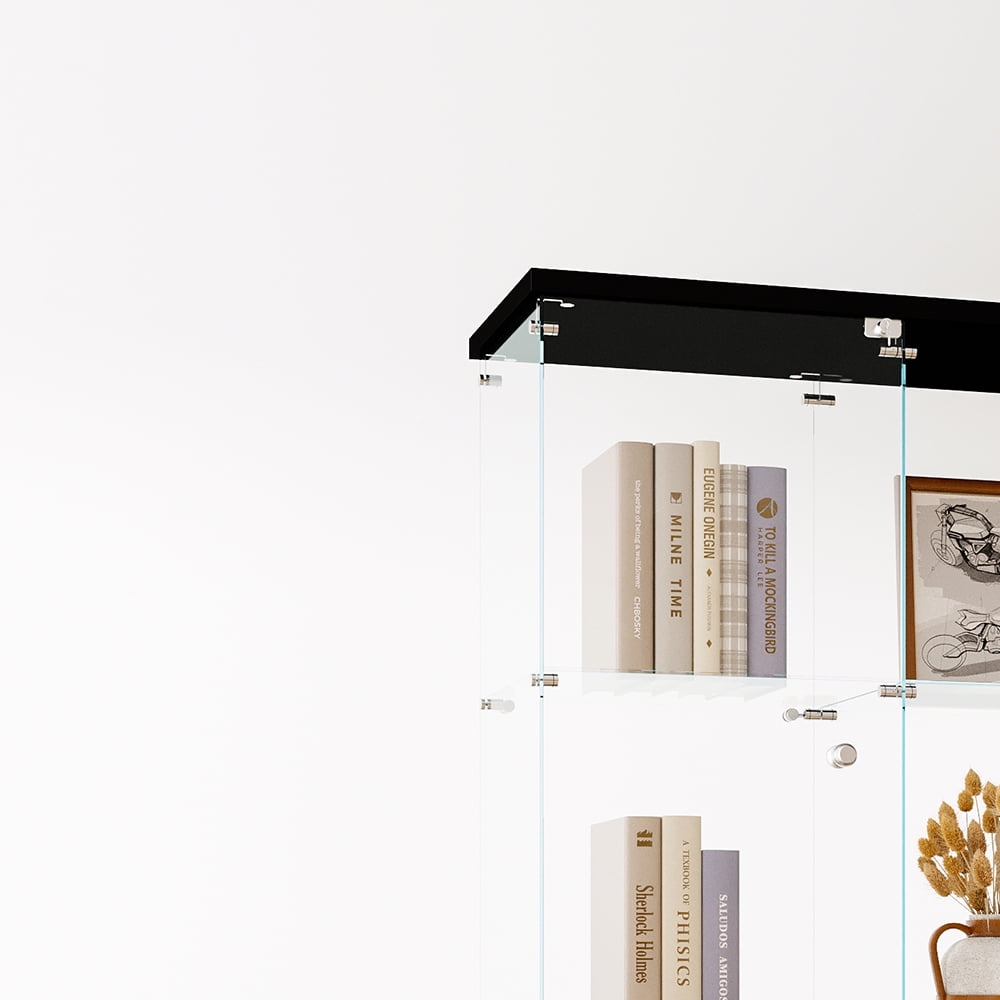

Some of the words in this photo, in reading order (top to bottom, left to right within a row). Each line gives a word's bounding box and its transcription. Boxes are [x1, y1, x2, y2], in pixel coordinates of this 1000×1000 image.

[634, 480, 642, 492] the
[703, 468, 715, 512] EUGENE
[634, 515, 642, 524] of
[703, 517, 715, 559] ONEGIN
[765, 527, 776, 541] TO
[670, 515, 682, 565] MILNE
[765, 543, 776, 564] KILL
[634, 551, 642, 588] wallflower
[765, 567, 776, 575] A
[633, 597, 641, 639] CHBOSKY
[670, 580, 682, 618] TIME
[765, 578, 776, 654] MOCKINGBIRD
[682, 850, 690, 889] TEXBOOK
[635, 885, 654, 935] Sherlock
[682, 894, 690, 905] OF
[719, 894, 728, 948] SALUDOS
[635, 941, 654, 984] Holmes
[676, 911, 690, 986] PHISICS
